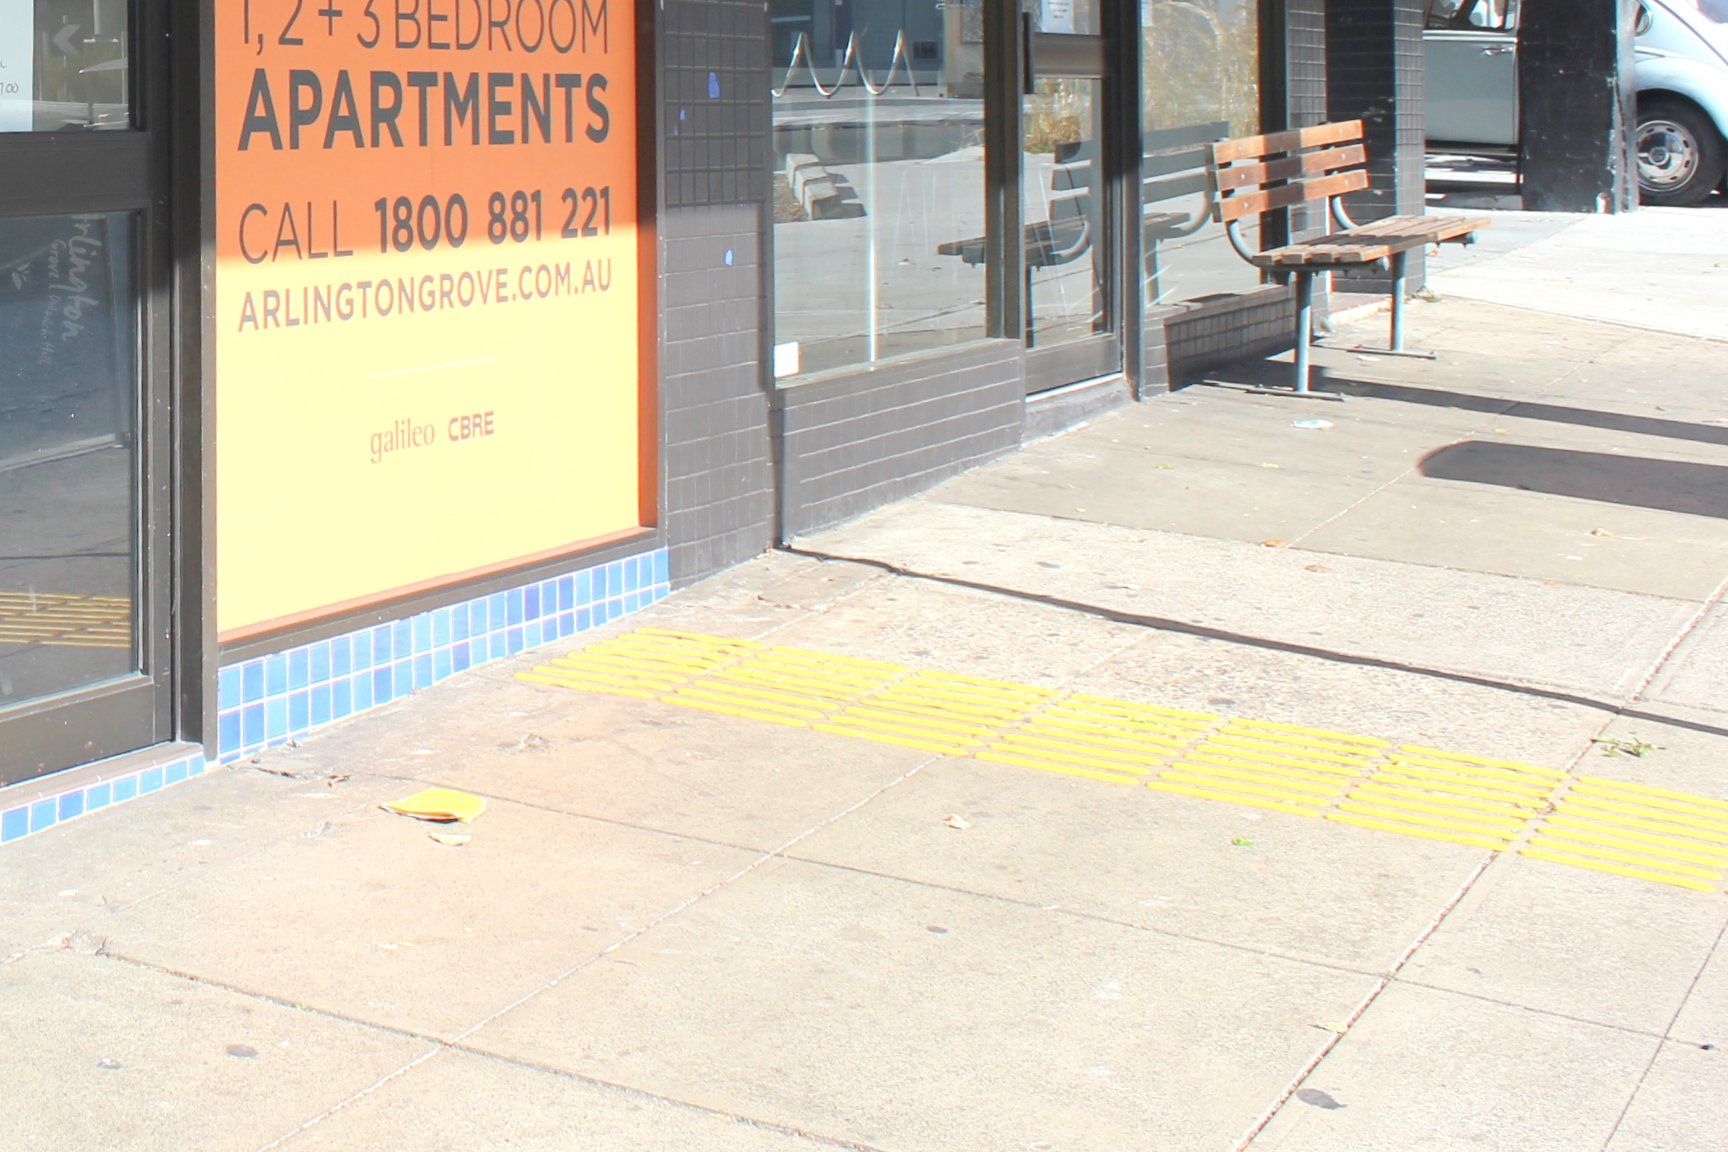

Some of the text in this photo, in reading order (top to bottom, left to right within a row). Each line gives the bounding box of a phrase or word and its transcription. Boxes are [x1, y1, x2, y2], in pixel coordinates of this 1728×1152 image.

[237, 68, 611, 151] APARTMENTS
[238, 185, 611, 265] CALL 1800 881 221
[238, 258, 612, 332] ARLINGTONGROVE.COM.AU
[370, 411, 495, 464] galileo CBRE
